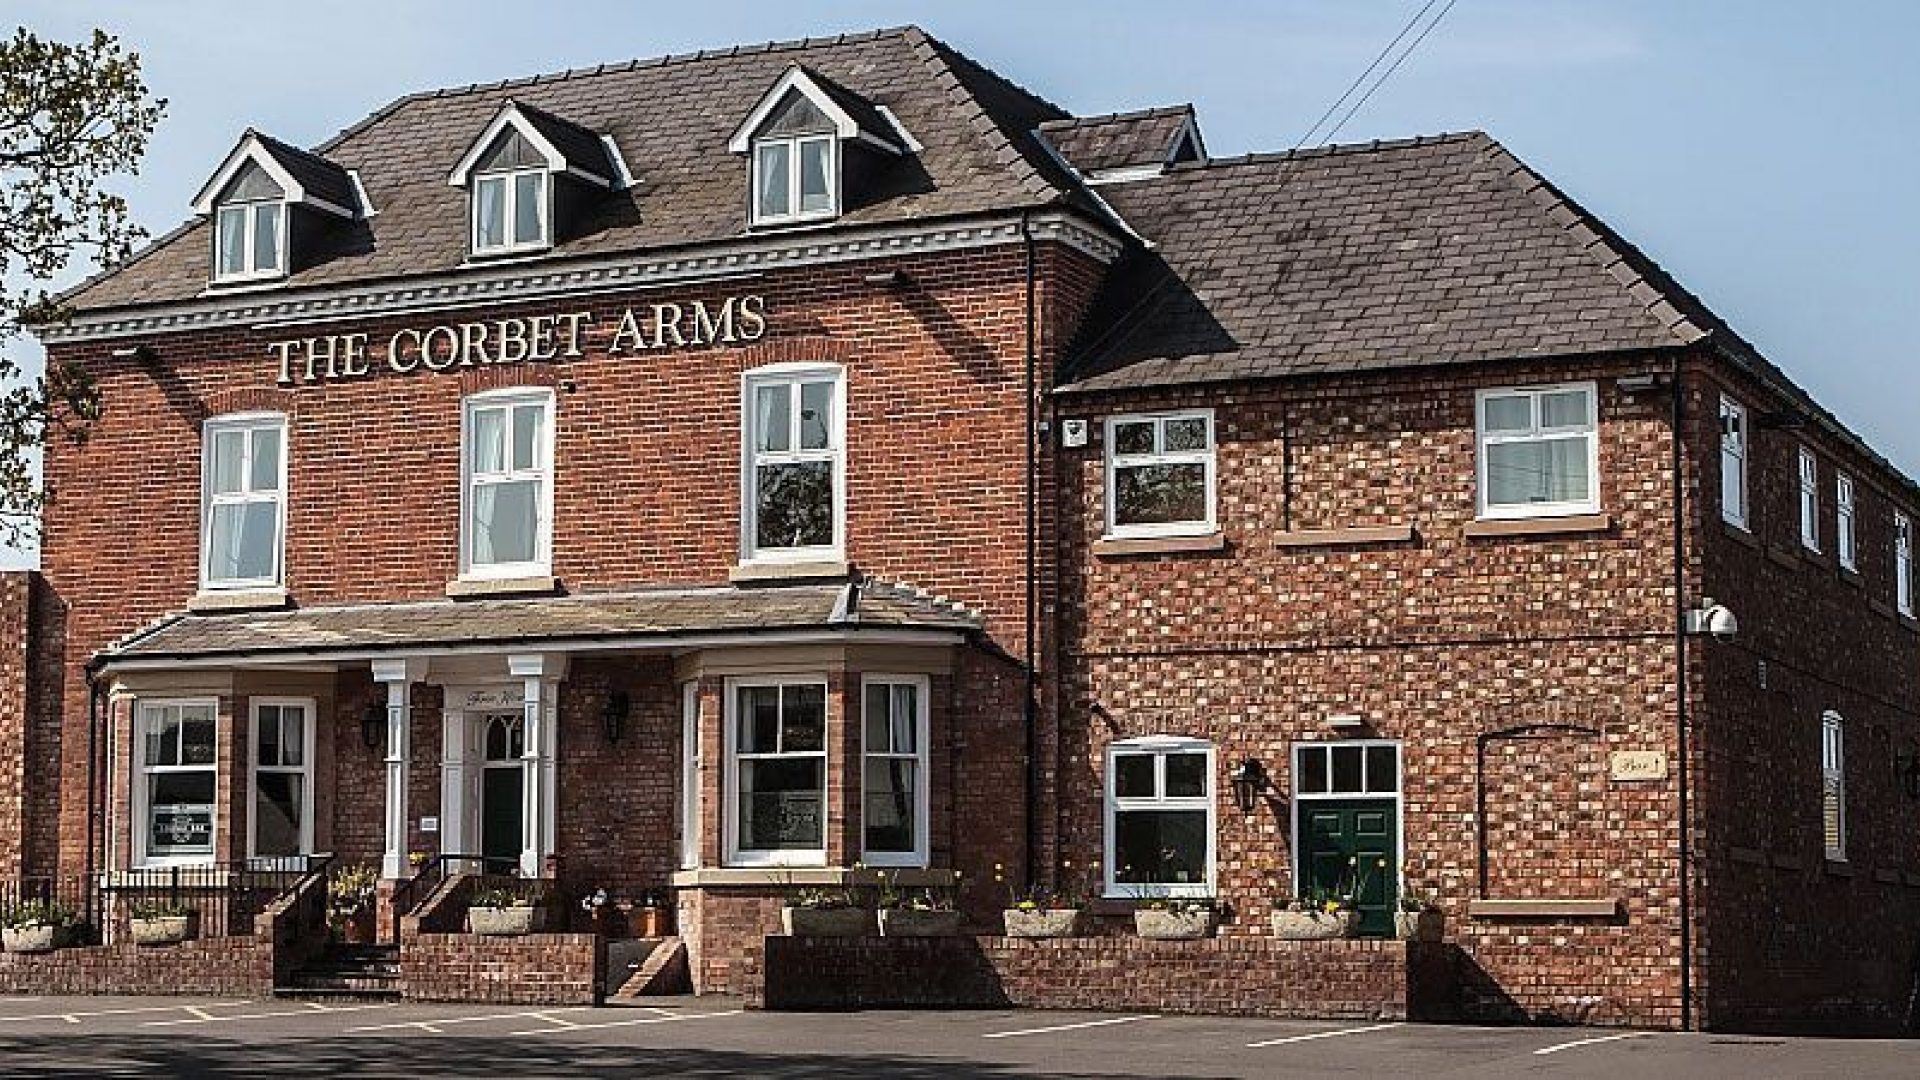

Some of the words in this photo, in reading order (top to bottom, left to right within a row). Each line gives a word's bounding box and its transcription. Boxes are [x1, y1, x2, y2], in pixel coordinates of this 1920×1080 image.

[268, 333, 368, 382] THE
[388, 311, 592, 373] CORBET
[608, 295, 766, 353] ARMS
